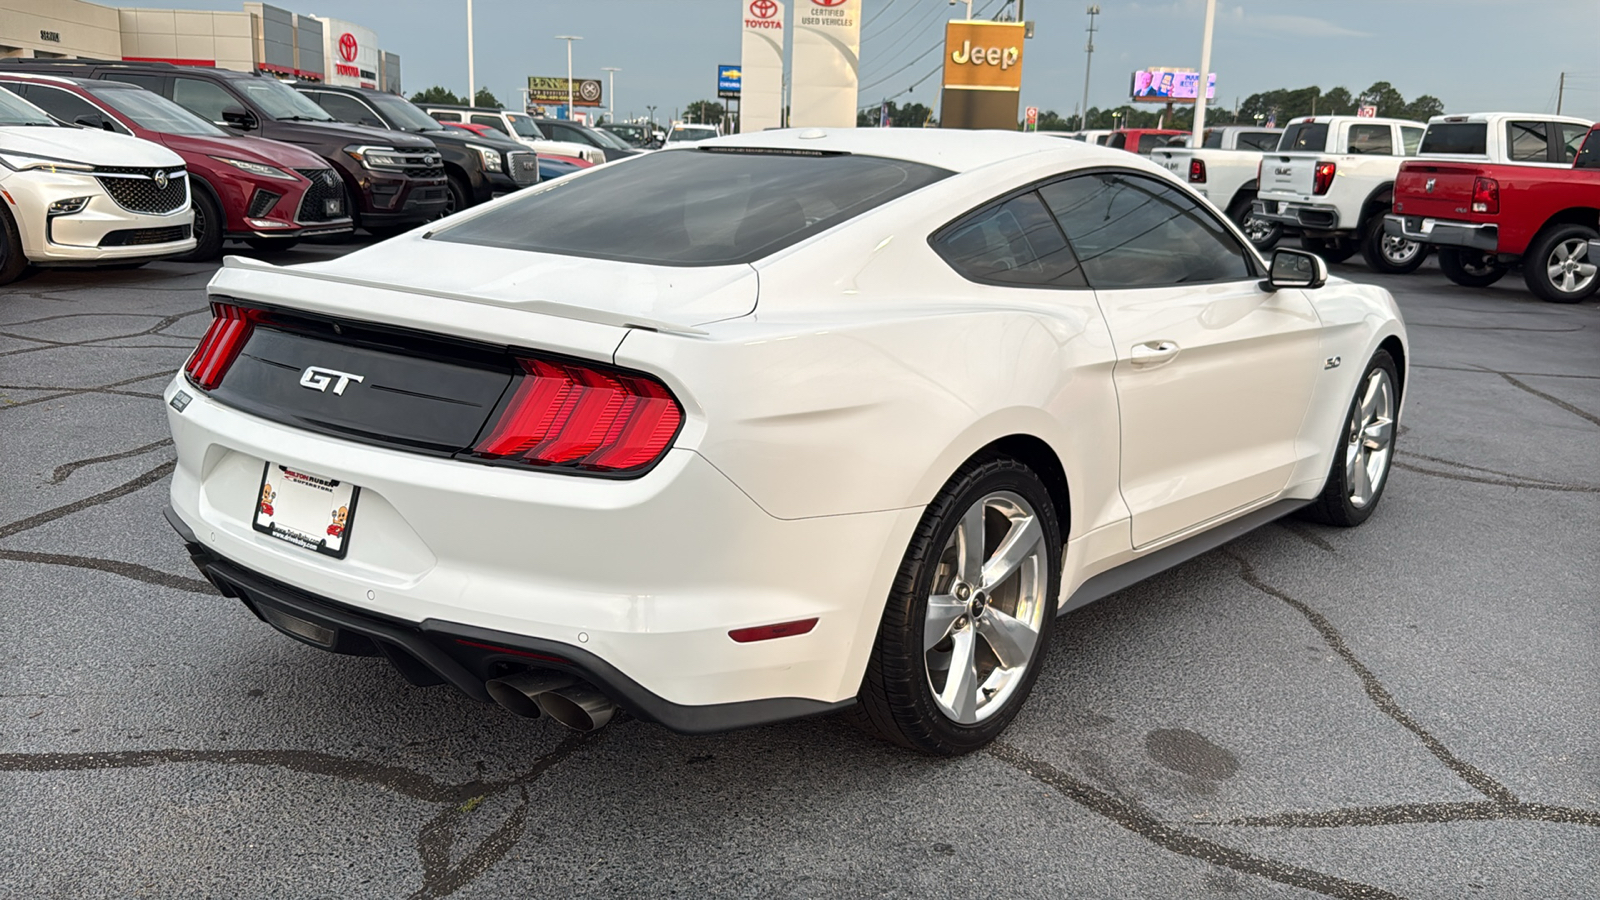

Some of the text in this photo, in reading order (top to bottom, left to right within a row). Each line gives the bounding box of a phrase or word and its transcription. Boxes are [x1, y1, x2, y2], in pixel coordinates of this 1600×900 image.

[811, 8, 845, 17] CERTIFIED
[745, 20, 782, 29] TOYOTA
[802, 17, 853, 26] USED VEHICLES
[952, 40, 1019, 70] Jeep
[336, 63, 359, 77] TOYOTA
[1275, 167, 1291, 176] GMC
[300, 366, 364, 396] GT
[284, 470, 309, 481] MILTON
[293, 479, 333, 493] SUPERSTORE
